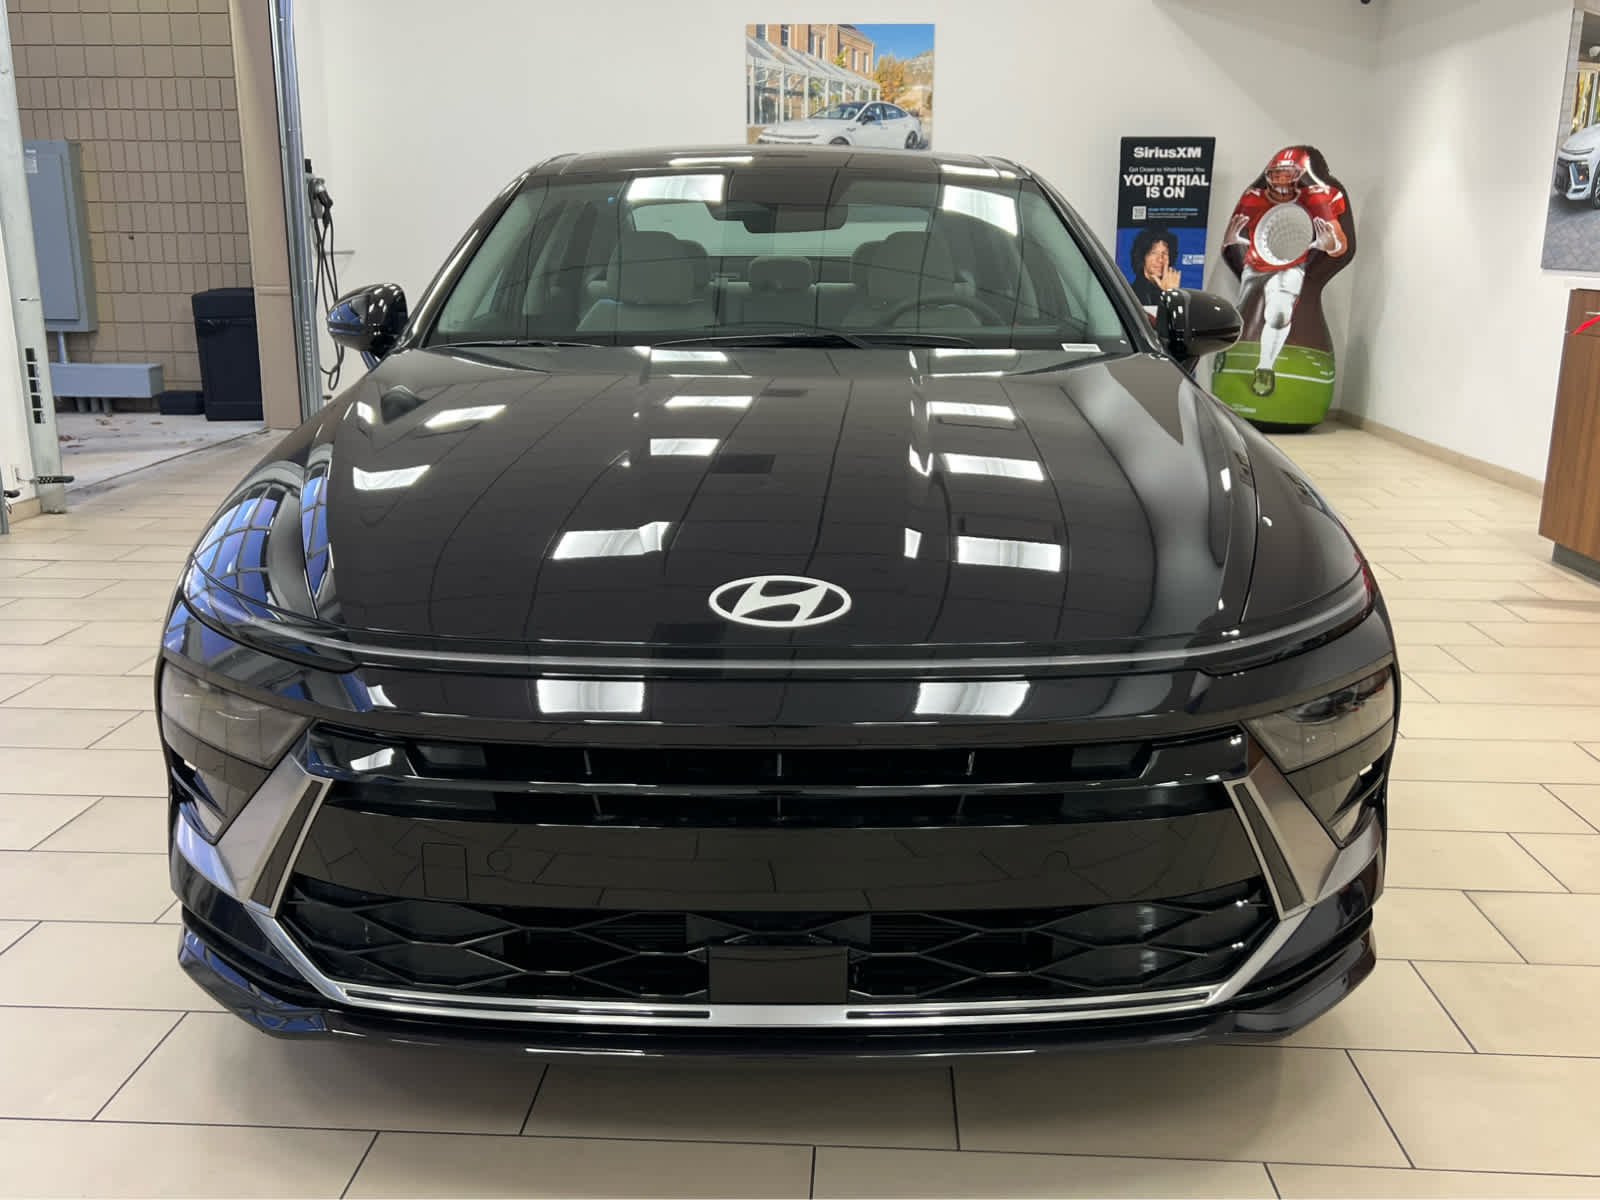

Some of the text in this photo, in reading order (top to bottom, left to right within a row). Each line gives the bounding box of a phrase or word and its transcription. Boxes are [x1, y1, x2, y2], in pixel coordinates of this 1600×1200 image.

[1133, 146, 1202, 158] SiriusXM
[1123, 174, 1209, 186] YOUR TRIAL
[1146, 186, 1185, 198] IS ON
